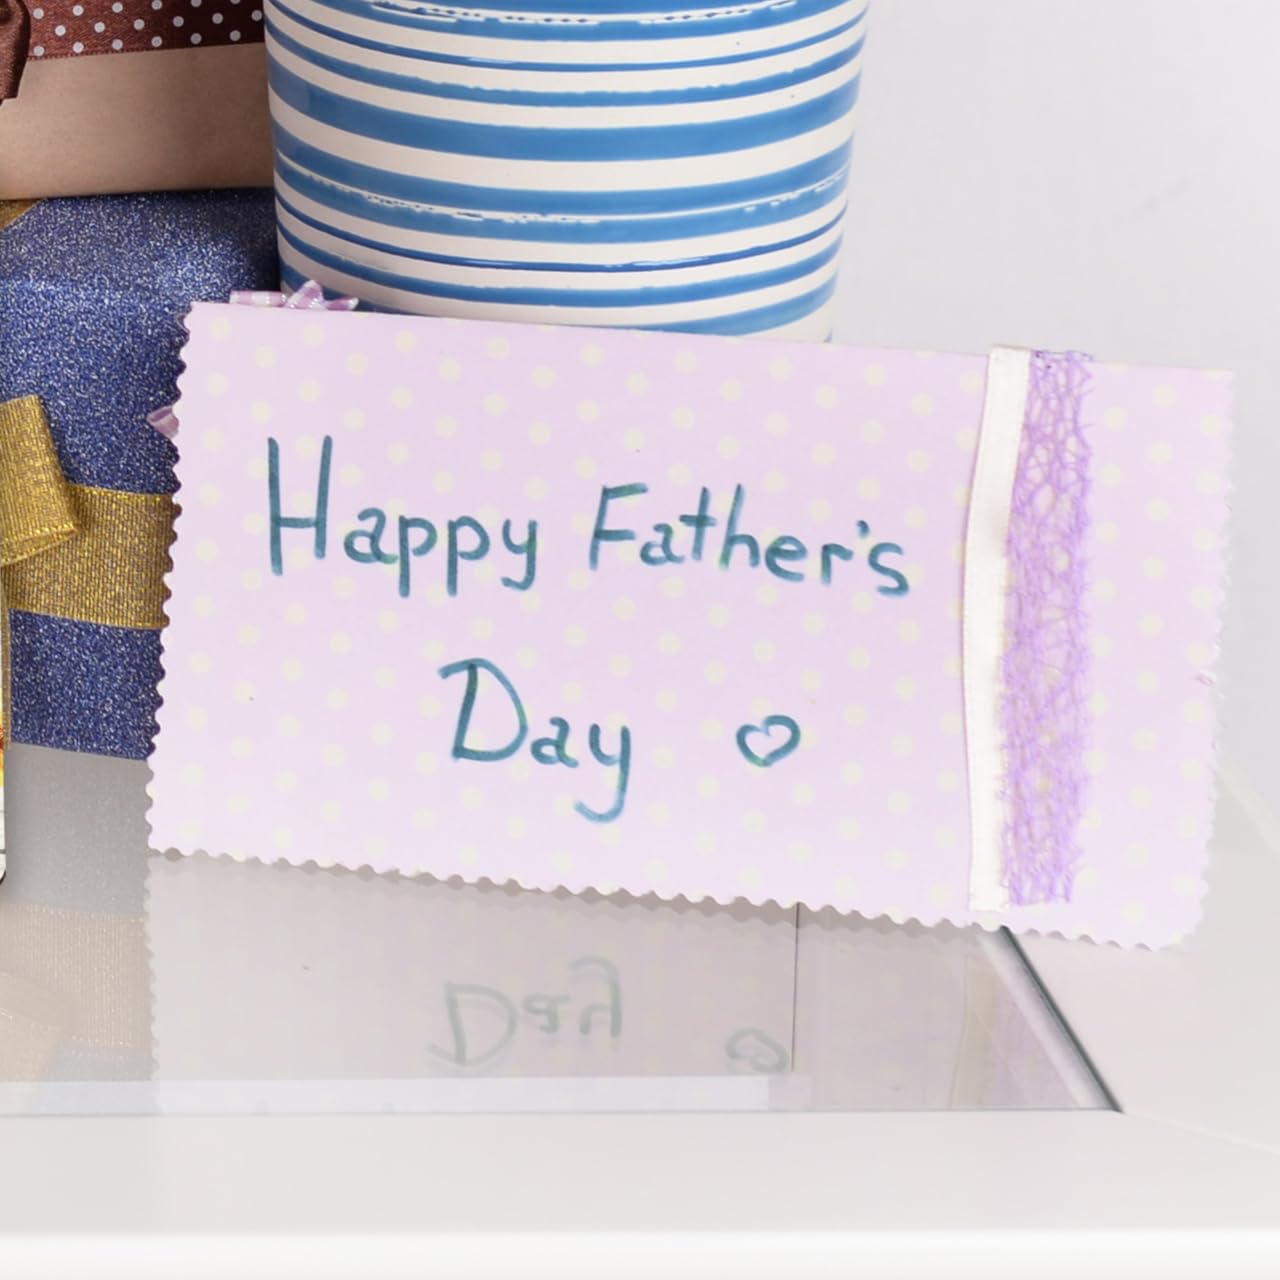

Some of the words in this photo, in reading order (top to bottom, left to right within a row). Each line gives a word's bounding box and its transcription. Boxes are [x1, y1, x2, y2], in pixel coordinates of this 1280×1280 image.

[266, 436, 540, 599] Happy
[587, 482, 911, 598] Father's
[438, 657, 633, 824] Day
